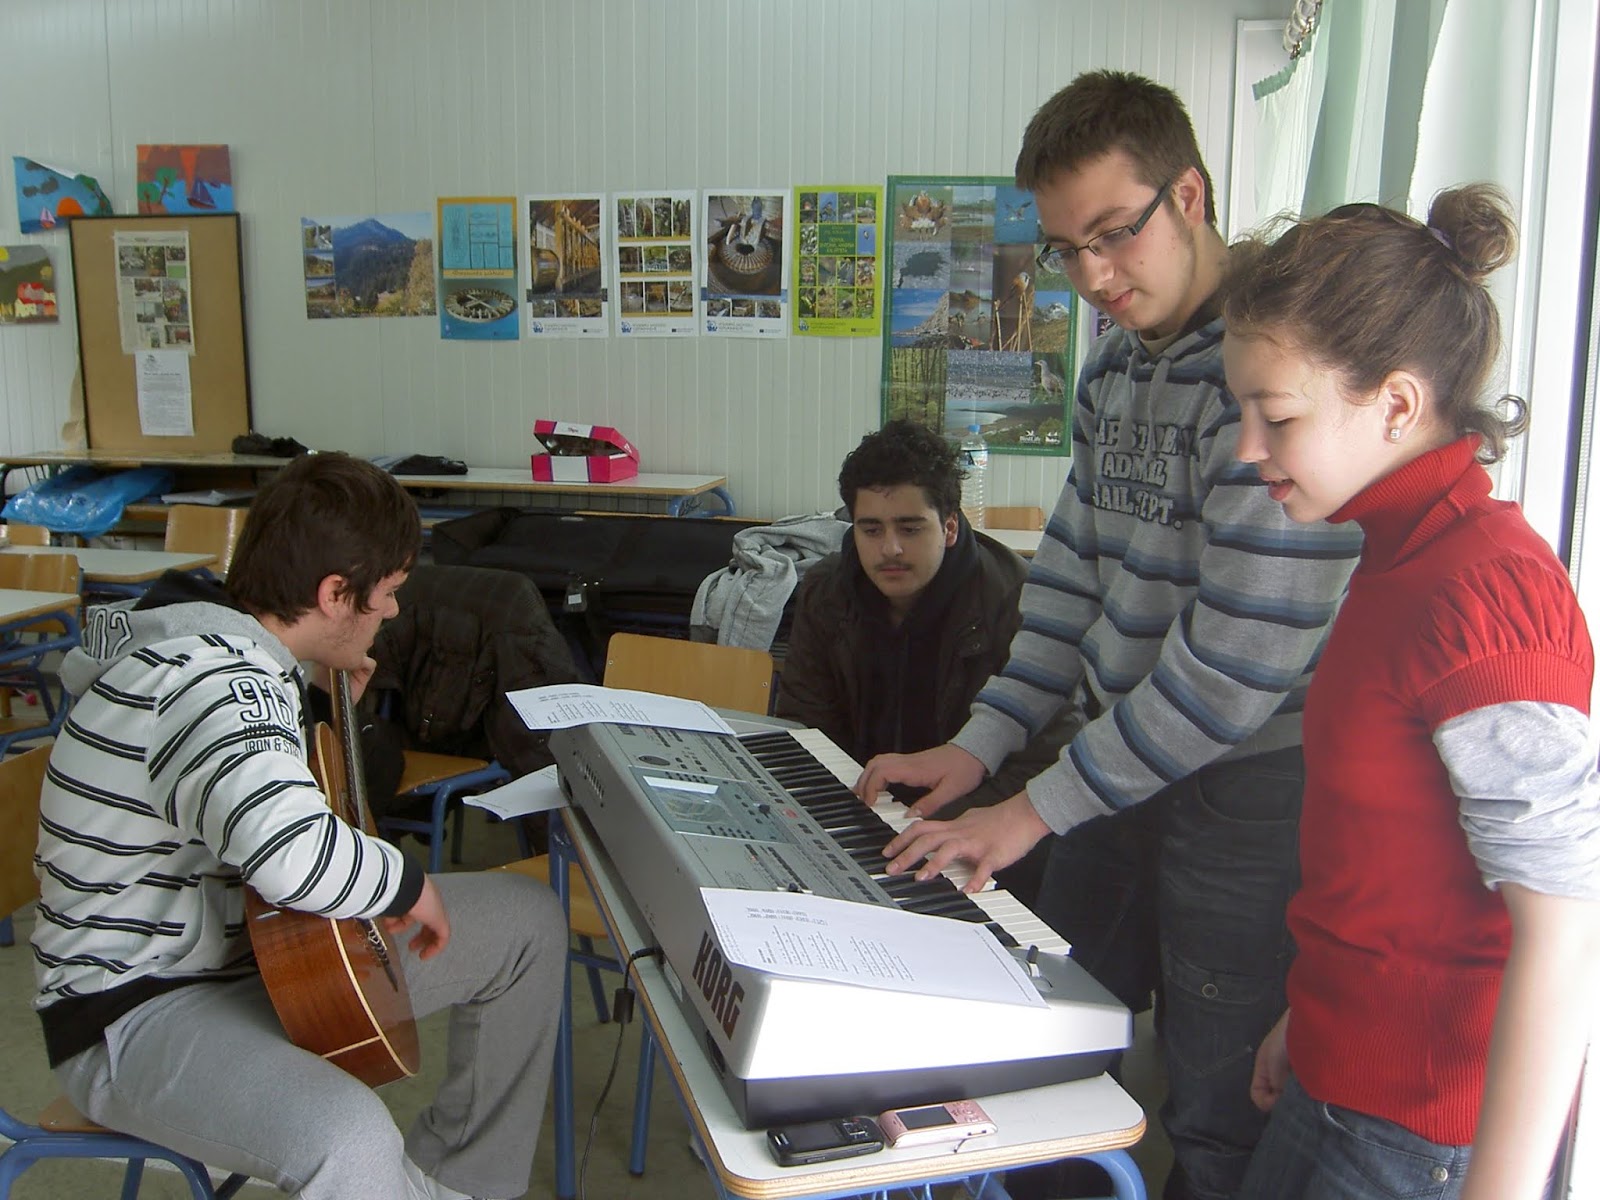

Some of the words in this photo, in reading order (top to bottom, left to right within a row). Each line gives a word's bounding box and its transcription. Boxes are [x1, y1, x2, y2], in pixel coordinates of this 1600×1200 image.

[229, 676, 297, 733] 96
[245, 738, 271, 752] IRON
[274, 737, 282, 751] &
[691, 930, 745, 1041] KORG
